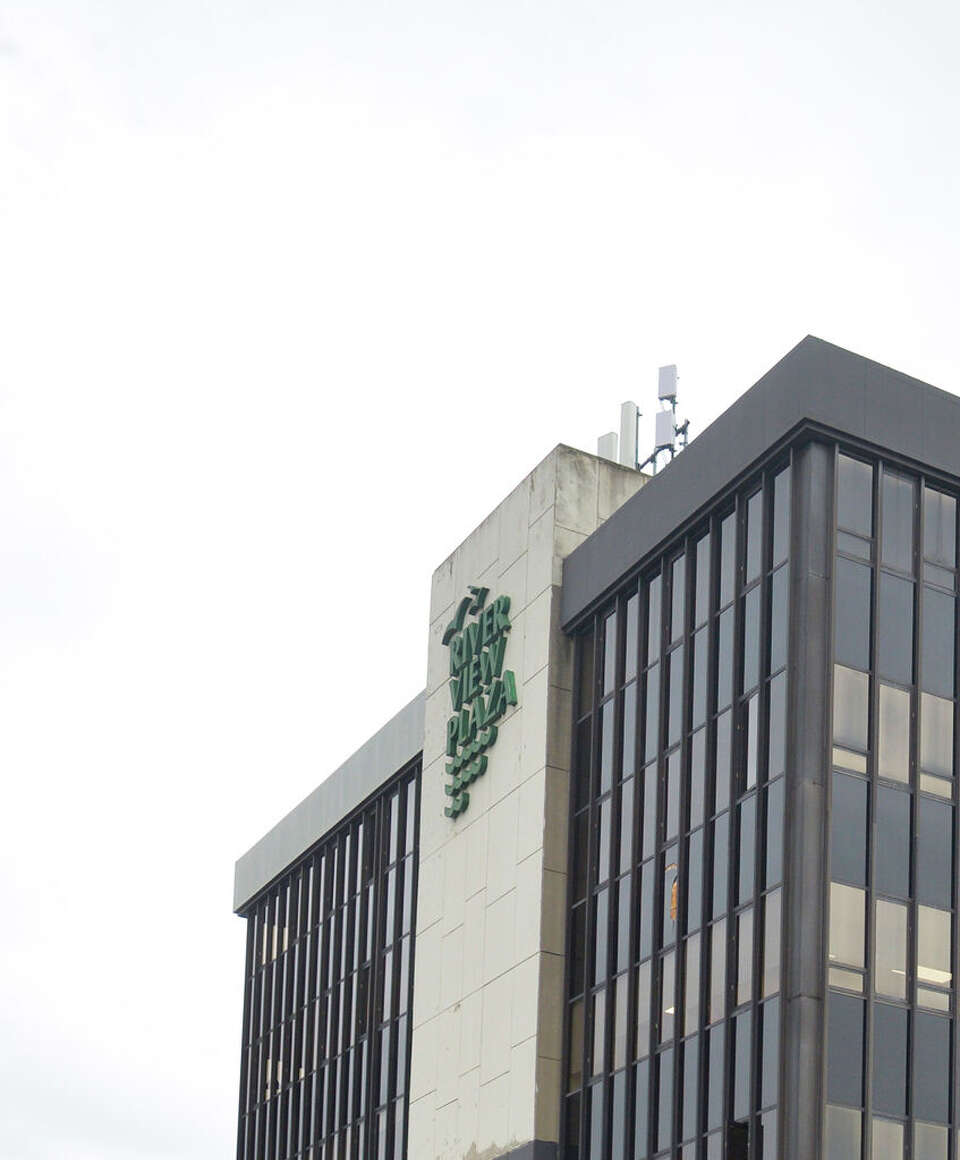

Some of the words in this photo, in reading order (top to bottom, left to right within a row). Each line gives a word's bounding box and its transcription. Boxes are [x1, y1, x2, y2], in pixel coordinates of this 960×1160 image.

[450, 595, 511, 677] RIVER
[450, 636, 508, 712] VIEW
[446, 669, 518, 758] PLAZA
